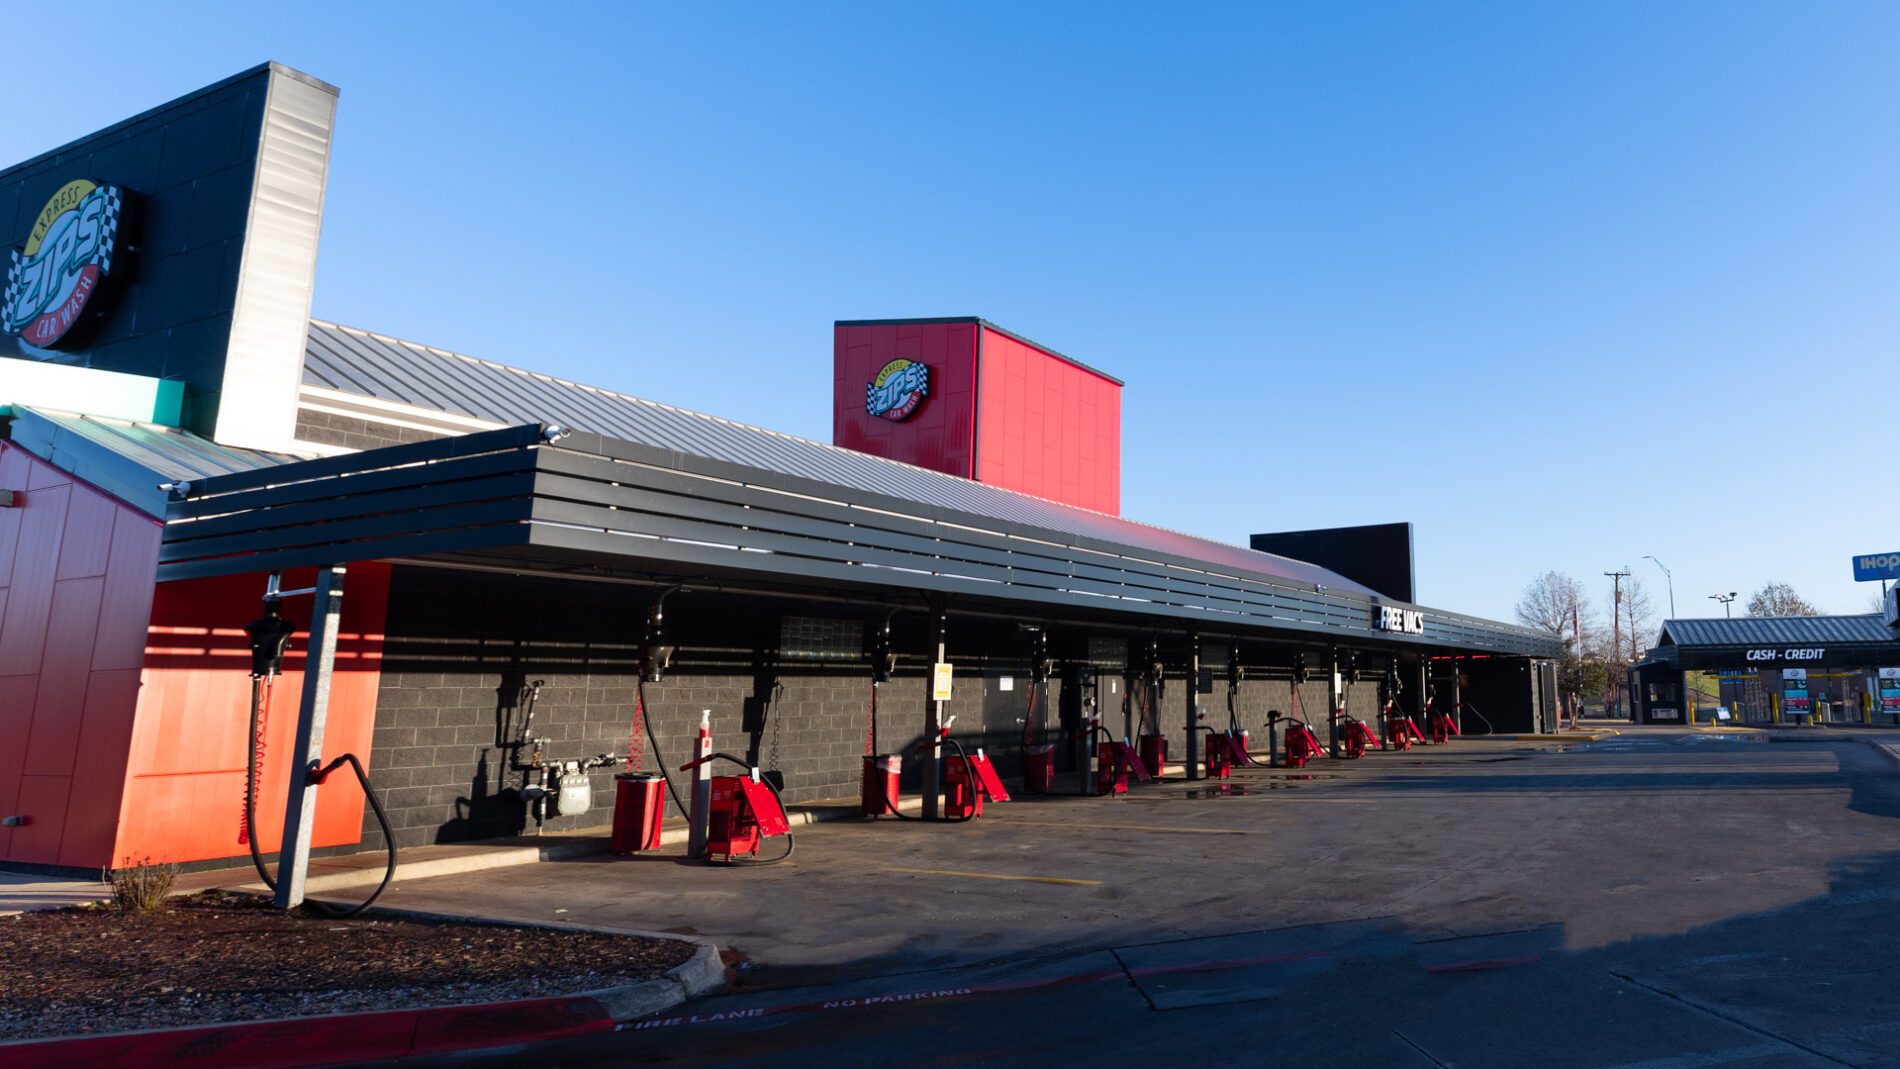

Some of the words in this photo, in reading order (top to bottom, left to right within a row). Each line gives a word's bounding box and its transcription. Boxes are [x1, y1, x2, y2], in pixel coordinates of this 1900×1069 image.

[33, 185, 80, 242] EXPRESS
[15, 196, 104, 322] ZIPS
[36, 319, 56, 339] CAR
[61, 275, 92, 326] WASH
[878, 361, 904, 382] EXPRESS
[876, 366, 917, 411] ZIPS
[1381, 605, 1403, 631] FREE
[1403, 609, 1424, 635] VACS
[1746, 649, 1776, 660] CASH
[1784, 648, 1825, 660] CREDIT
[823, 1000, 857, 1009] NO
[865, 988, 972, 1005] PARKING
[614, 1017, 682, 1032] FIRE
[690, 1008, 765, 1023] LANE
